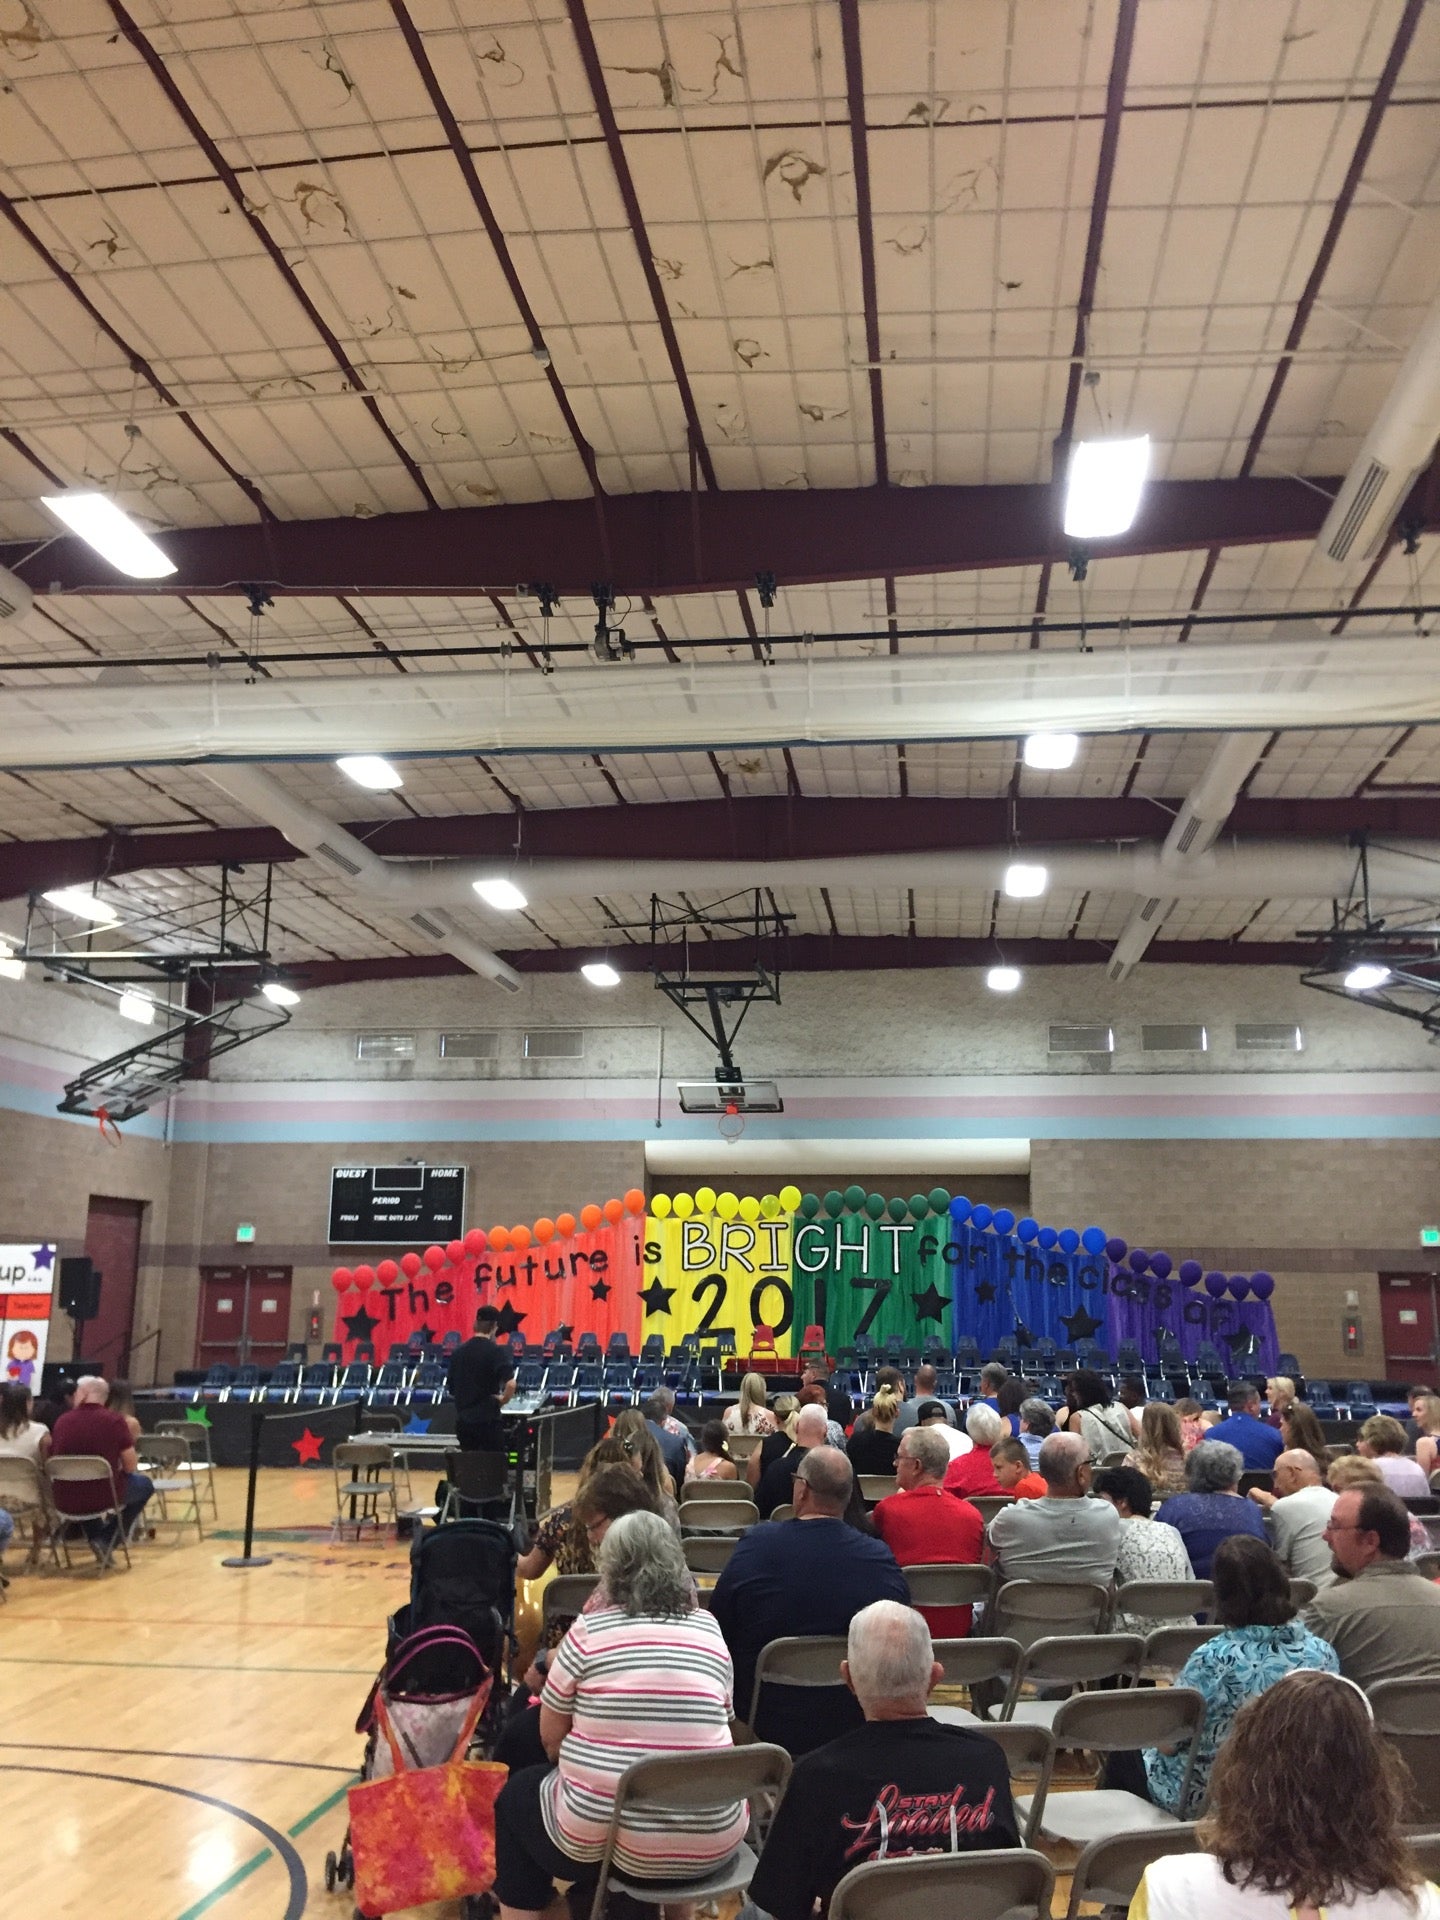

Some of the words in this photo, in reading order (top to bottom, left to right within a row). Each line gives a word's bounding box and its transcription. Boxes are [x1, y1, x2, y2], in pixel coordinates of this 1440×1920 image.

[336, 1169, 367, 1178] GUEST
[430, 1169, 459, 1178] HOME
[372, 1197, 400, 1205] PERIOD
[381, 1282, 454, 1321] The
[474, 1250, 609, 1293] future
[634, 1235, 663, 1266] is
[682, 1221, 914, 1274] BRIGHT
[917, 1235, 987, 1269] for
[1002, 1246, 1069, 1286] the
[1078, 1262, 1173, 1309] class
[1182, 1300, 1234, 1334] of
[691, 1274, 893, 1340] 2017
[898, 1793, 952, 1809] STAY
[841, 1784, 996, 1859] Loaded
